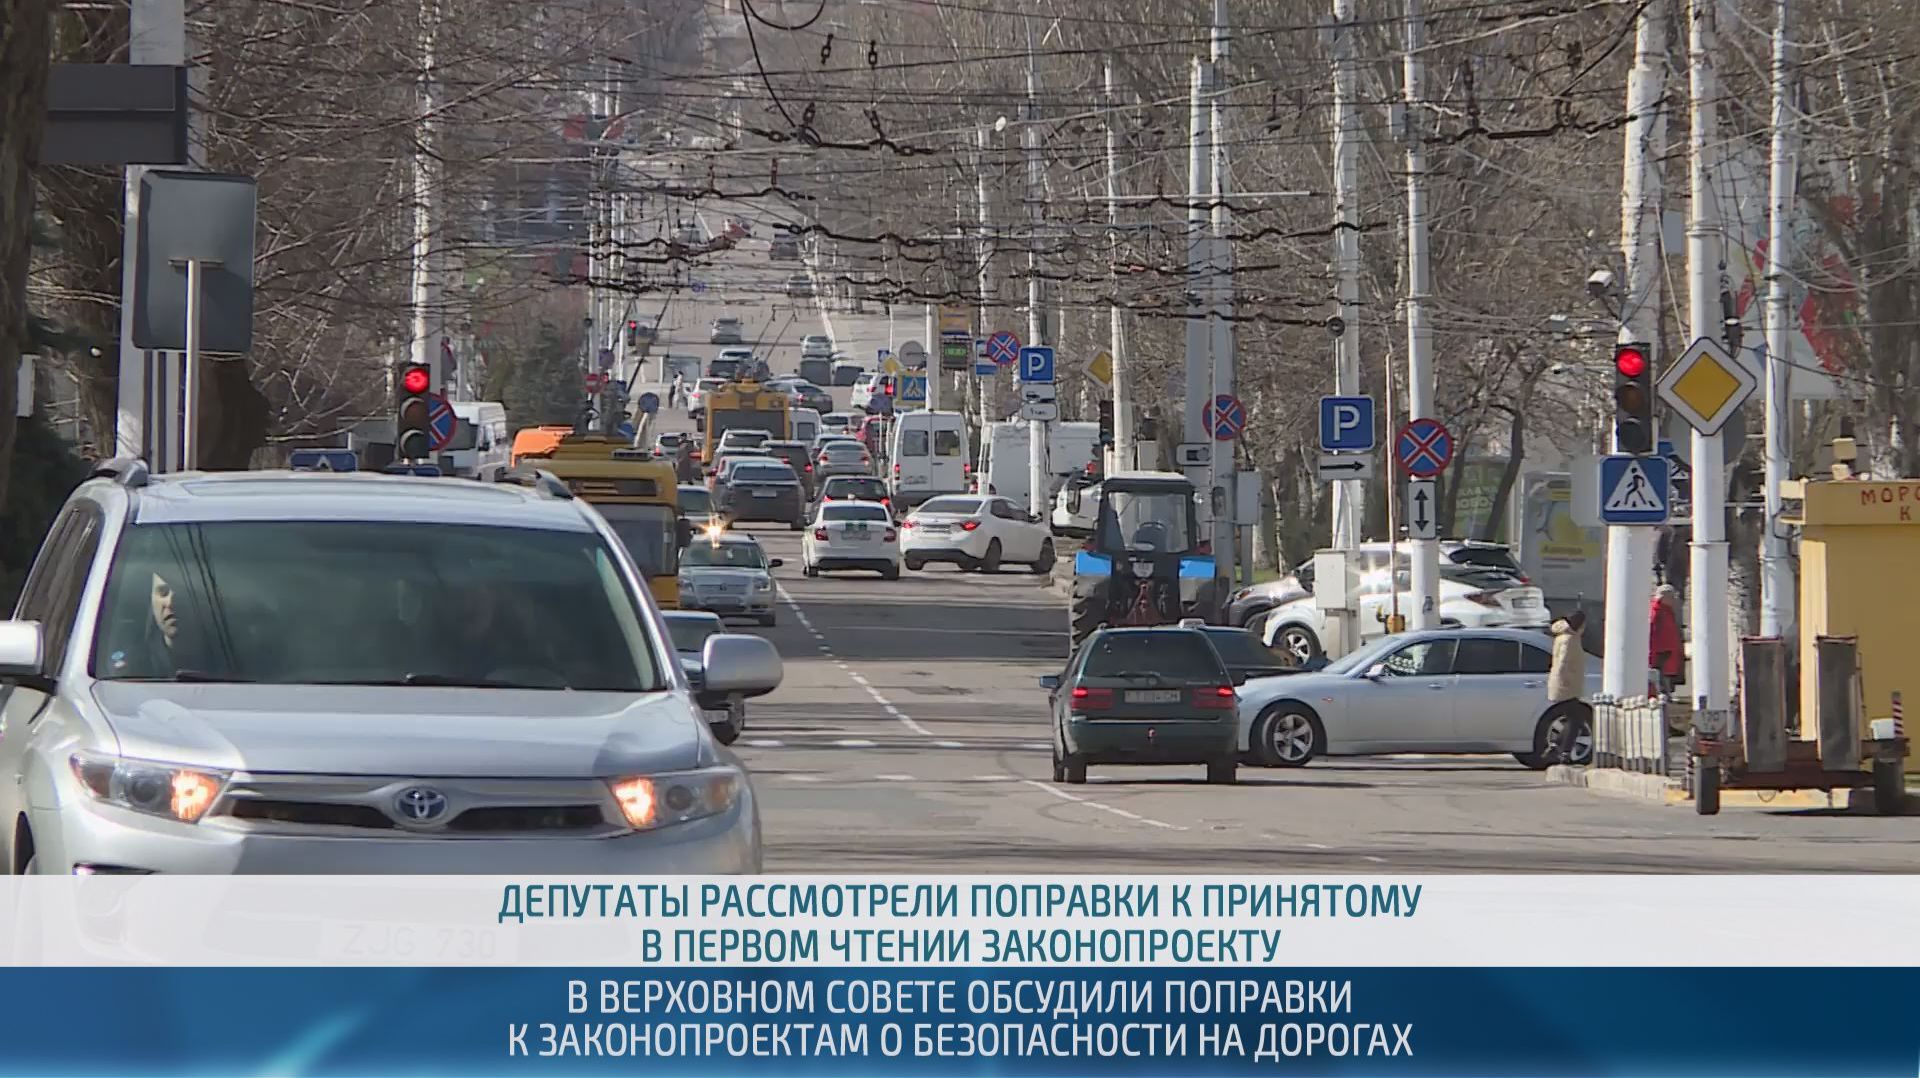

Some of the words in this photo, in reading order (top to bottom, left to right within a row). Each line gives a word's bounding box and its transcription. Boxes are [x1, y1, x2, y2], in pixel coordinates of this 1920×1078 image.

[1028, 353, 1045, 377] P
[1334, 405, 1360, 441] P
[343, 925, 417, 955] ZJG
[437, 928, 496, 959] 730
